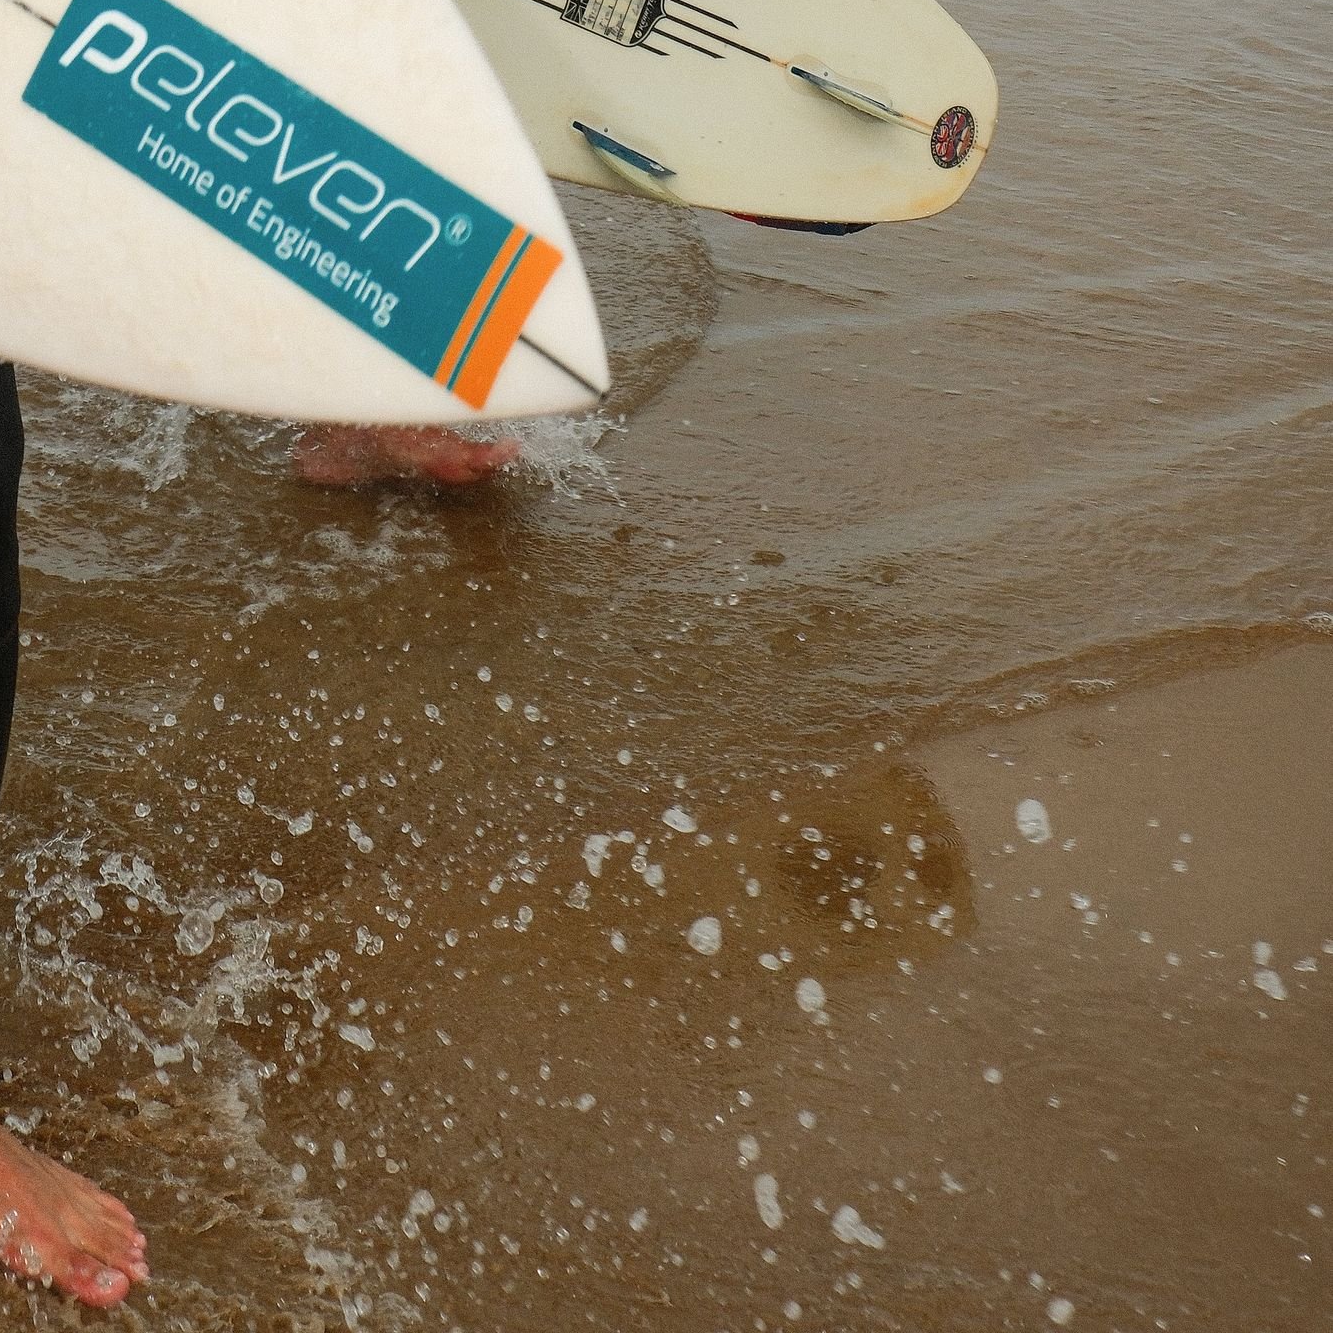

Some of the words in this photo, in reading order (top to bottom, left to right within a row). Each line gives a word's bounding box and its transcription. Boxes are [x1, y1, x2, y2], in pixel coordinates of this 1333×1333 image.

[136, 124, 215, 196] Home
[216, 183, 253, 215] of
[246, 197, 400, 328] Engineering
